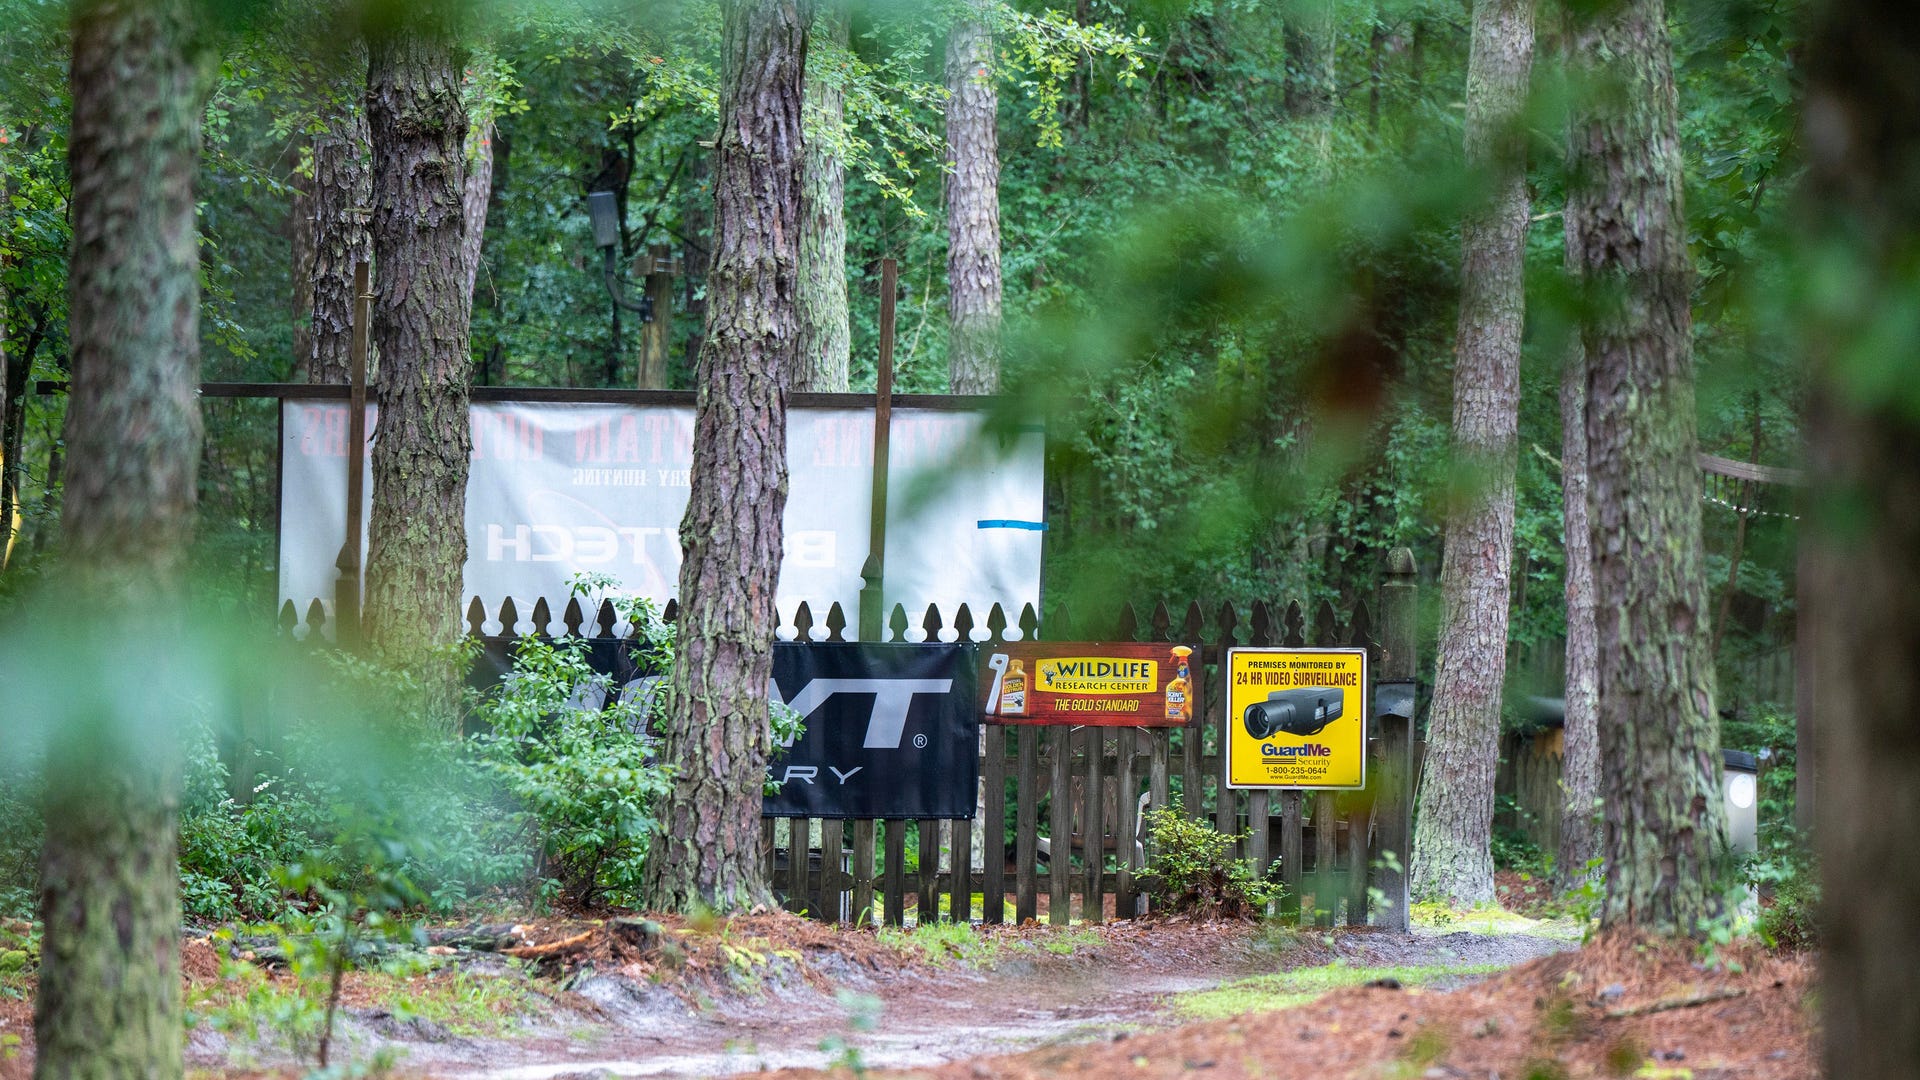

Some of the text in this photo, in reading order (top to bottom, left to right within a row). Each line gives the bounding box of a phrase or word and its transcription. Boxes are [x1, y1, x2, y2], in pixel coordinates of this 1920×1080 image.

[1057, 662, 1150, 678] WILDLIFE
[1248, 661, 1287, 669] PREMISES
[1236, 672, 1357, 686] 24 HR VIDEO SURVEILLANCE
[1055, 682, 1148, 690] RESEARCH CENTER
[1055, 698, 1140, 711] THE GOLD STANDARD
[1261, 743, 1331, 756] GuardMe
[1298, 757, 1331, 767] Security
[1266, 766, 1327, 774] 1-800-235-0644
